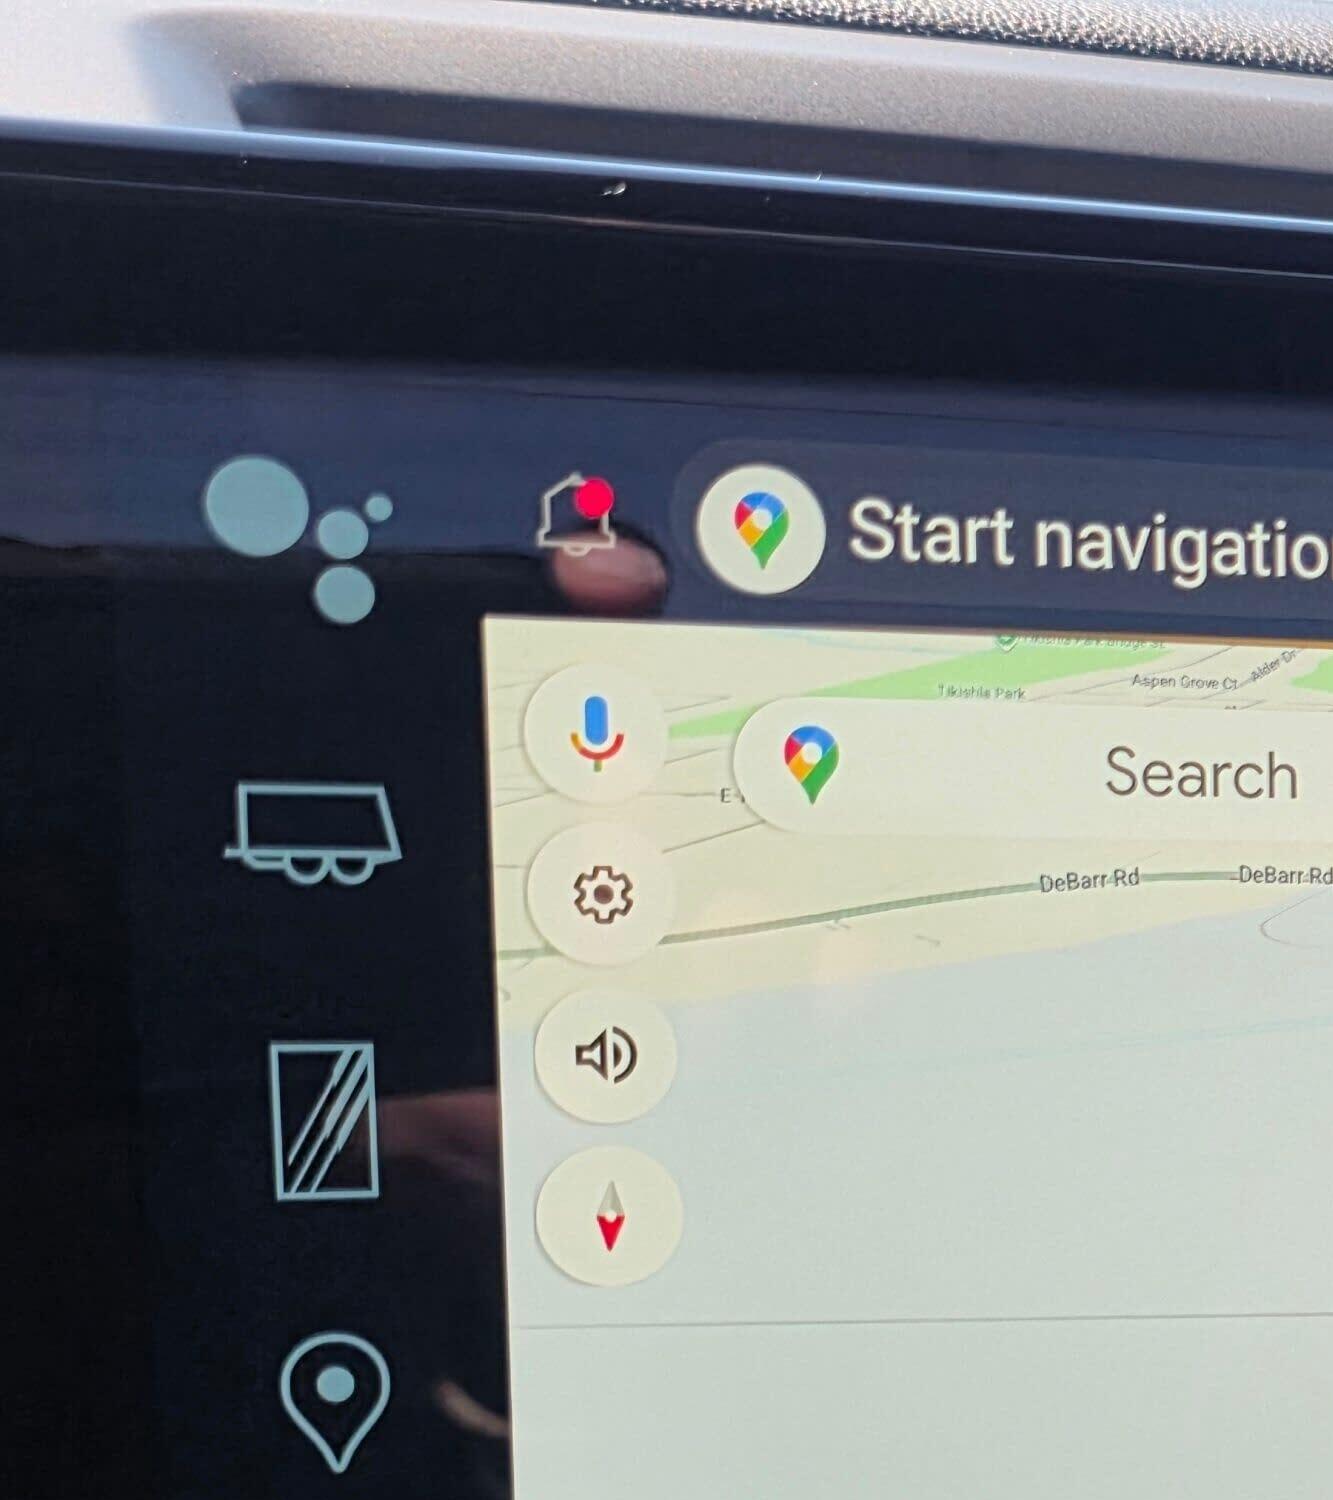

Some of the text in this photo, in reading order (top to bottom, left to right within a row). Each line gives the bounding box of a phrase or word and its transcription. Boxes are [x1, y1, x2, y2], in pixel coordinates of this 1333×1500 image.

[848, 498, 1013, 567] Start
[1106, 746, 1298, 802] Search
[1040, 867, 1140, 894] DeBarr Rd
[1239, 865, 1303, 885] DeBarr
